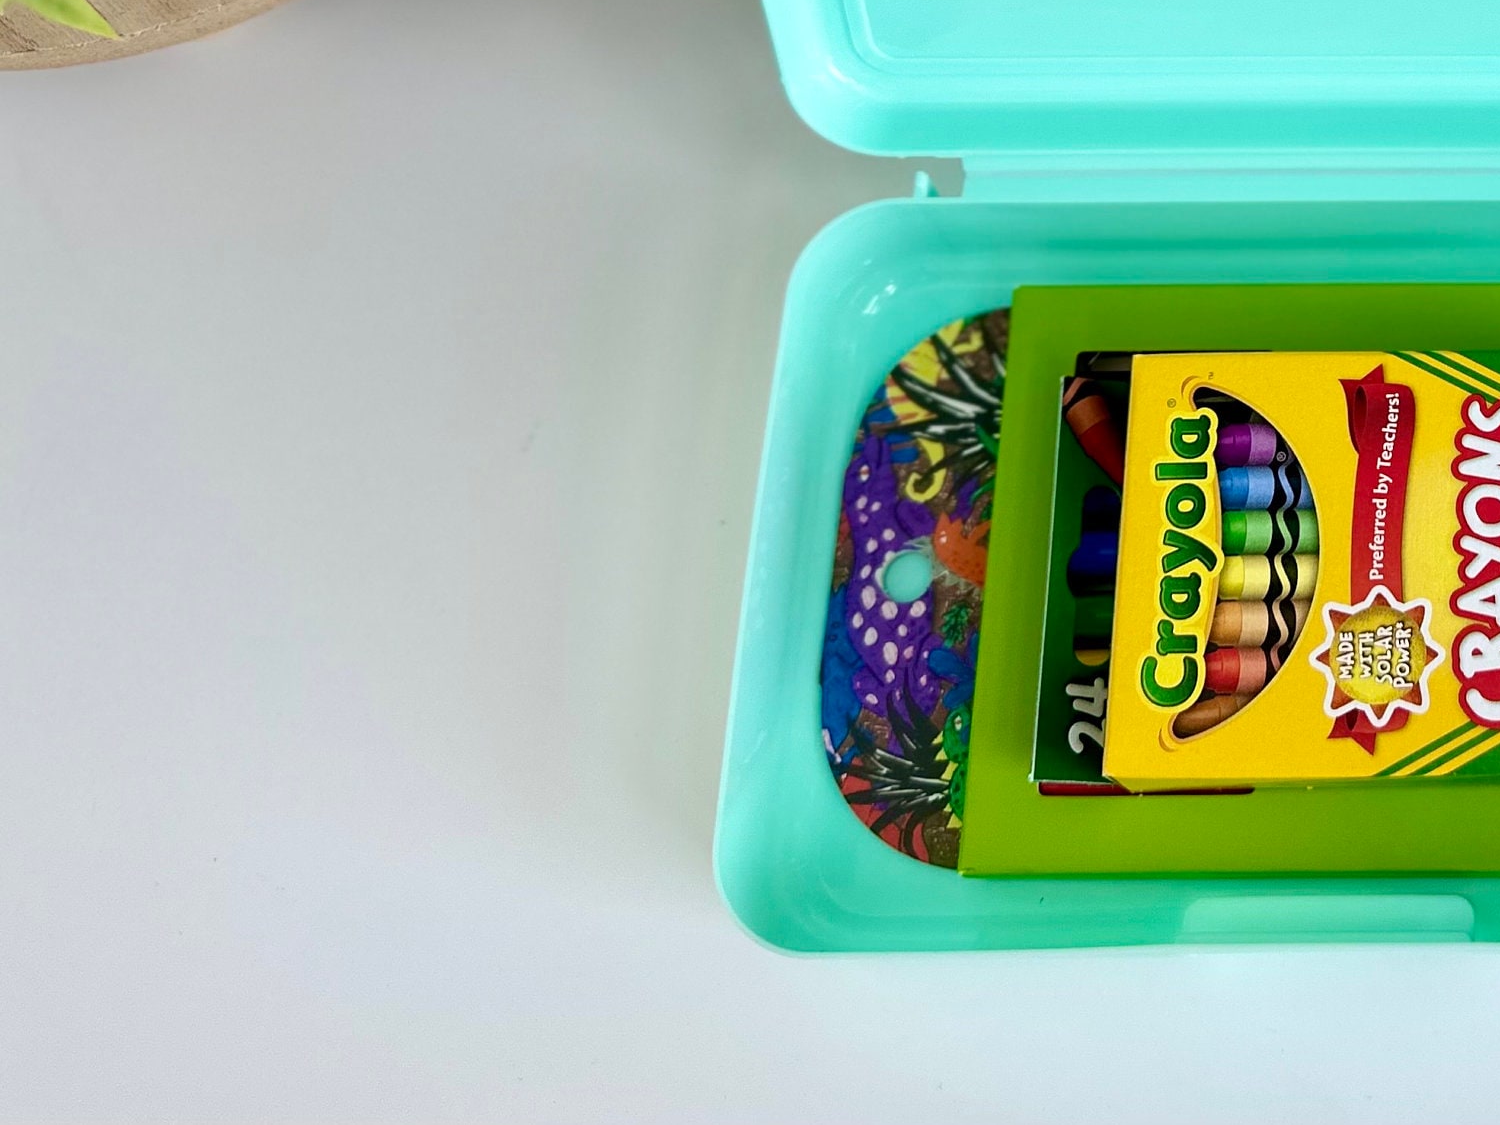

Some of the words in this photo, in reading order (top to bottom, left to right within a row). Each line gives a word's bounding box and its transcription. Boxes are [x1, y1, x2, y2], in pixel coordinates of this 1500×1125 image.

[1376, 392, 1400, 470] Teachers!
[1373, 473, 1393, 494] by
[1142, 415, 1219, 708] Crayola
[1368, 498, 1388, 580] Preferred
[1336, 631, 1355, 680] MADE
[1358, 631, 1375, 679] WITH
[1374, 625, 1394, 684] SOLAR
[1065, 677, 1108, 754] 24
